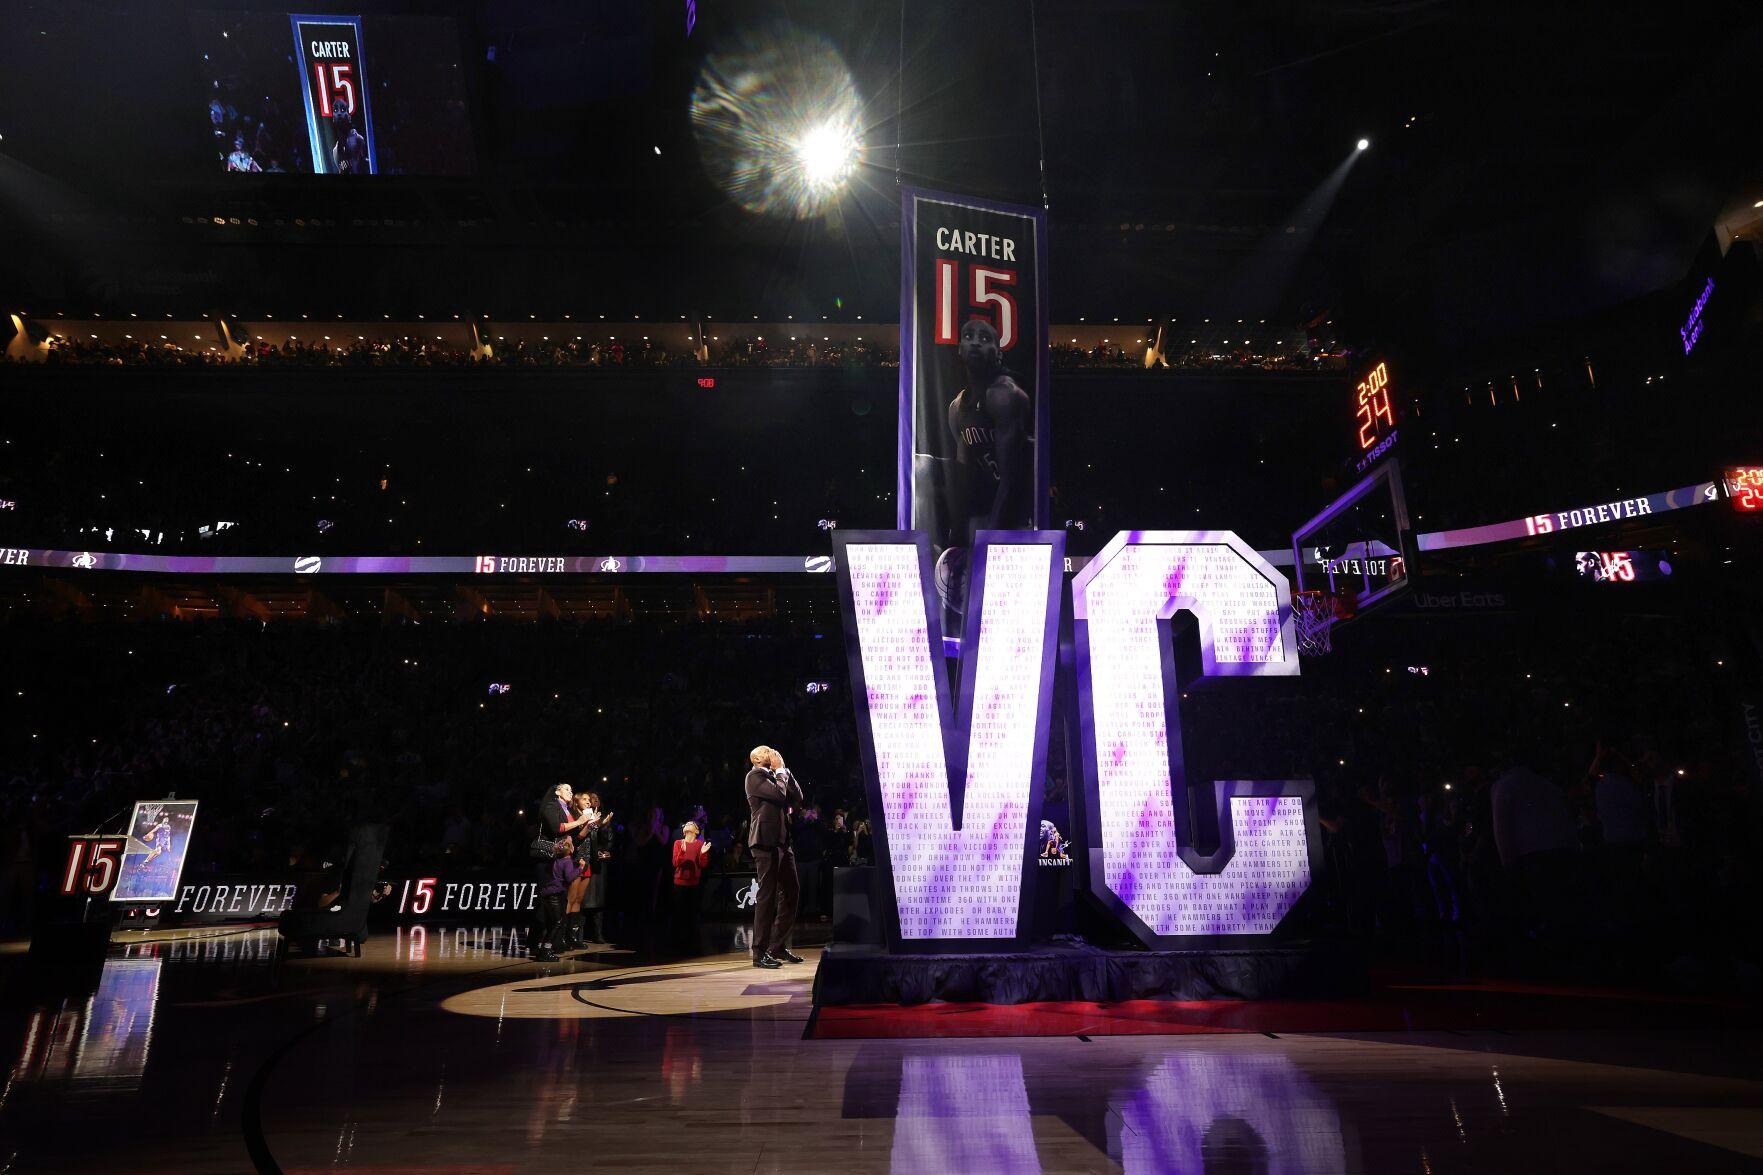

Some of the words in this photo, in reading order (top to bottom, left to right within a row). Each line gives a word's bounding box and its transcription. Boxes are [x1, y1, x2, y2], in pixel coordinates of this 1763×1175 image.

[311, 40, 351, 58] CARTER
[314, 62, 357, 118] 15
[936, 227, 1016, 262] CARTER
[934, 258, 1018, 353] 15
[1357, 362, 1388, 406] 2:00
[1356, 388, 1394, 449] 24
[1524, 513, 1554, 536] 15
[1557, 497, 1653, 530] FOREVER
[475, 555, 496, 574] 15
[500, 556, 566, 573] FOREVER
[63, 841, 119, 895] 15
[174, 885, 297, 913] FOREVER
[398, 878, 437, 914] 15
